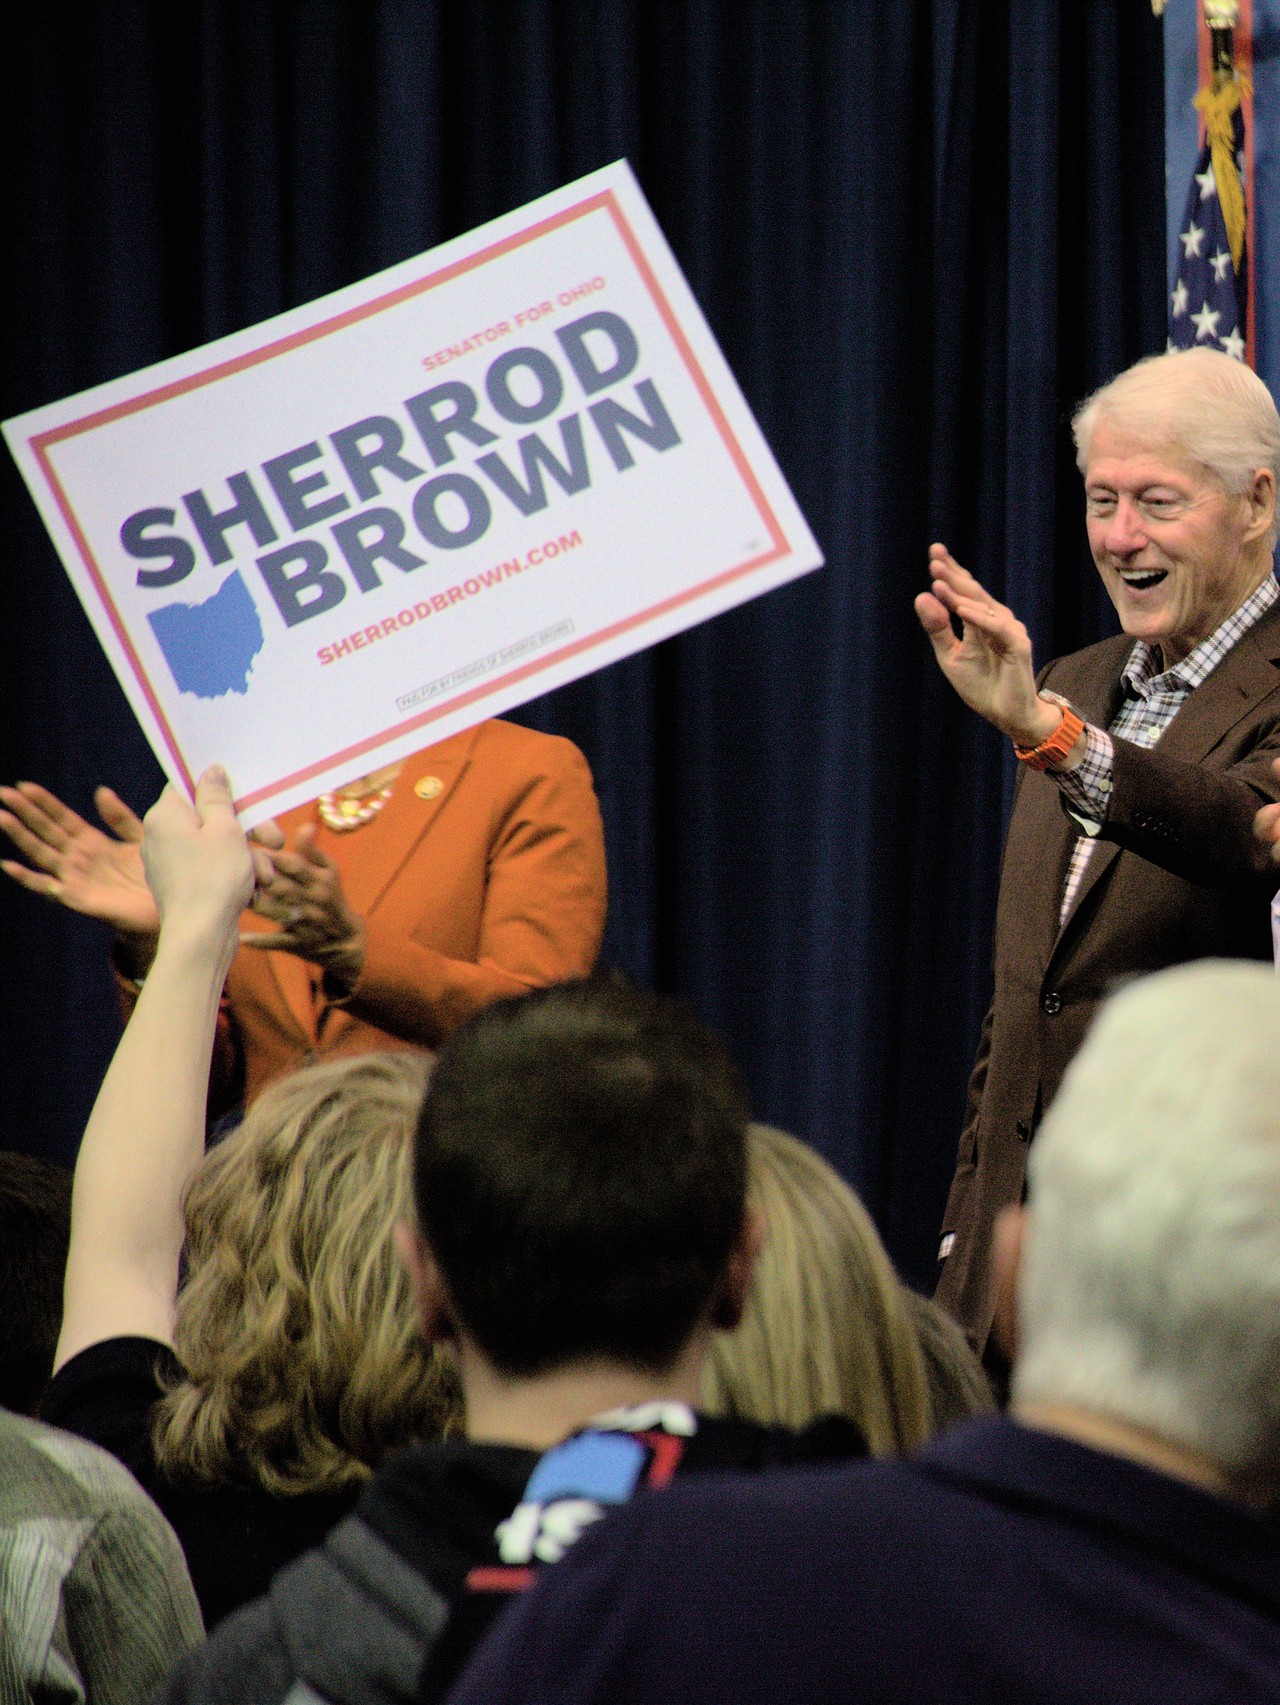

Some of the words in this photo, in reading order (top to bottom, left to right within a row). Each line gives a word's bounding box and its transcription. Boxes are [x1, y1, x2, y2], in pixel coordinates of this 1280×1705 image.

[421, 321, 511, 372] SENATOR
[514, 300, 554, 327] FOR
[558, 276, 606, 306] OHIO
[119, 310, 640, 588] SHERROD
[255, 377, 683, 629] BROWN
[316, 531, 583, 665] SHERRODBROWN.COM
